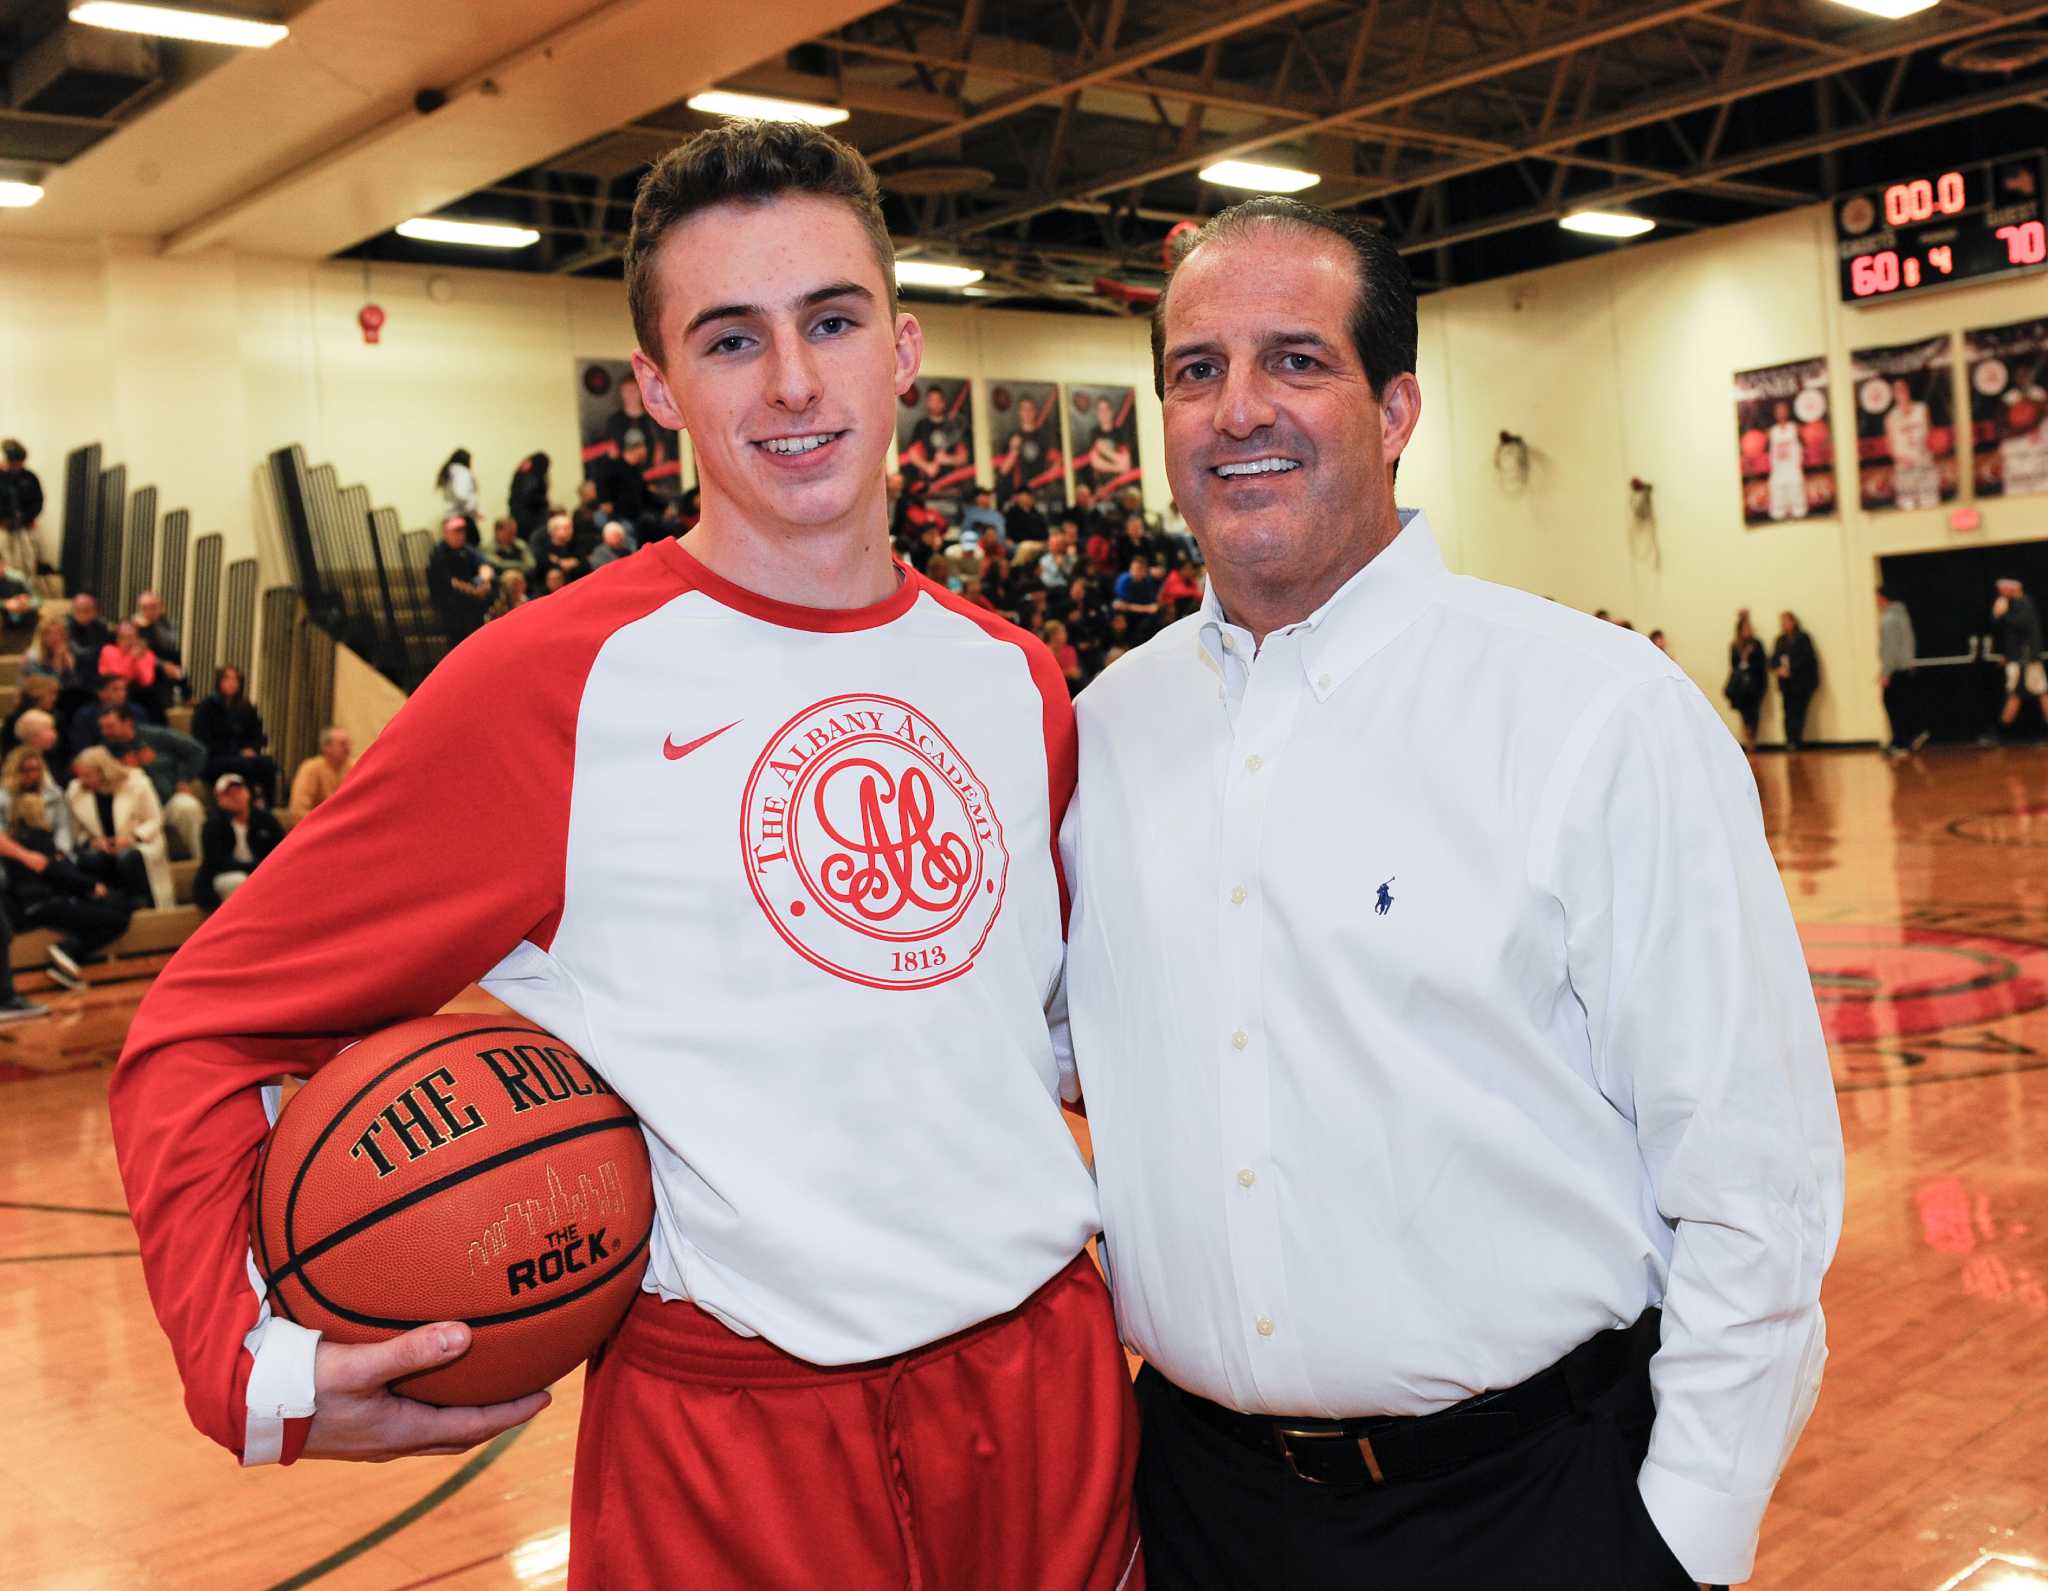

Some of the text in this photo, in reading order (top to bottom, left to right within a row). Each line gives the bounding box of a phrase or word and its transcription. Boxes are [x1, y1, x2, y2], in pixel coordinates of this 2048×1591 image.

[1995, 220, 2046, 264] 70
[1852, 251, 1899, 296] 60
[753, 711, 995, 874] THE ALBANY ACADEMY
[891, 945, 946, 972] 1813
[349, 1066, 487, 1179] THE
[544, 1223, 579, 1248] THE
